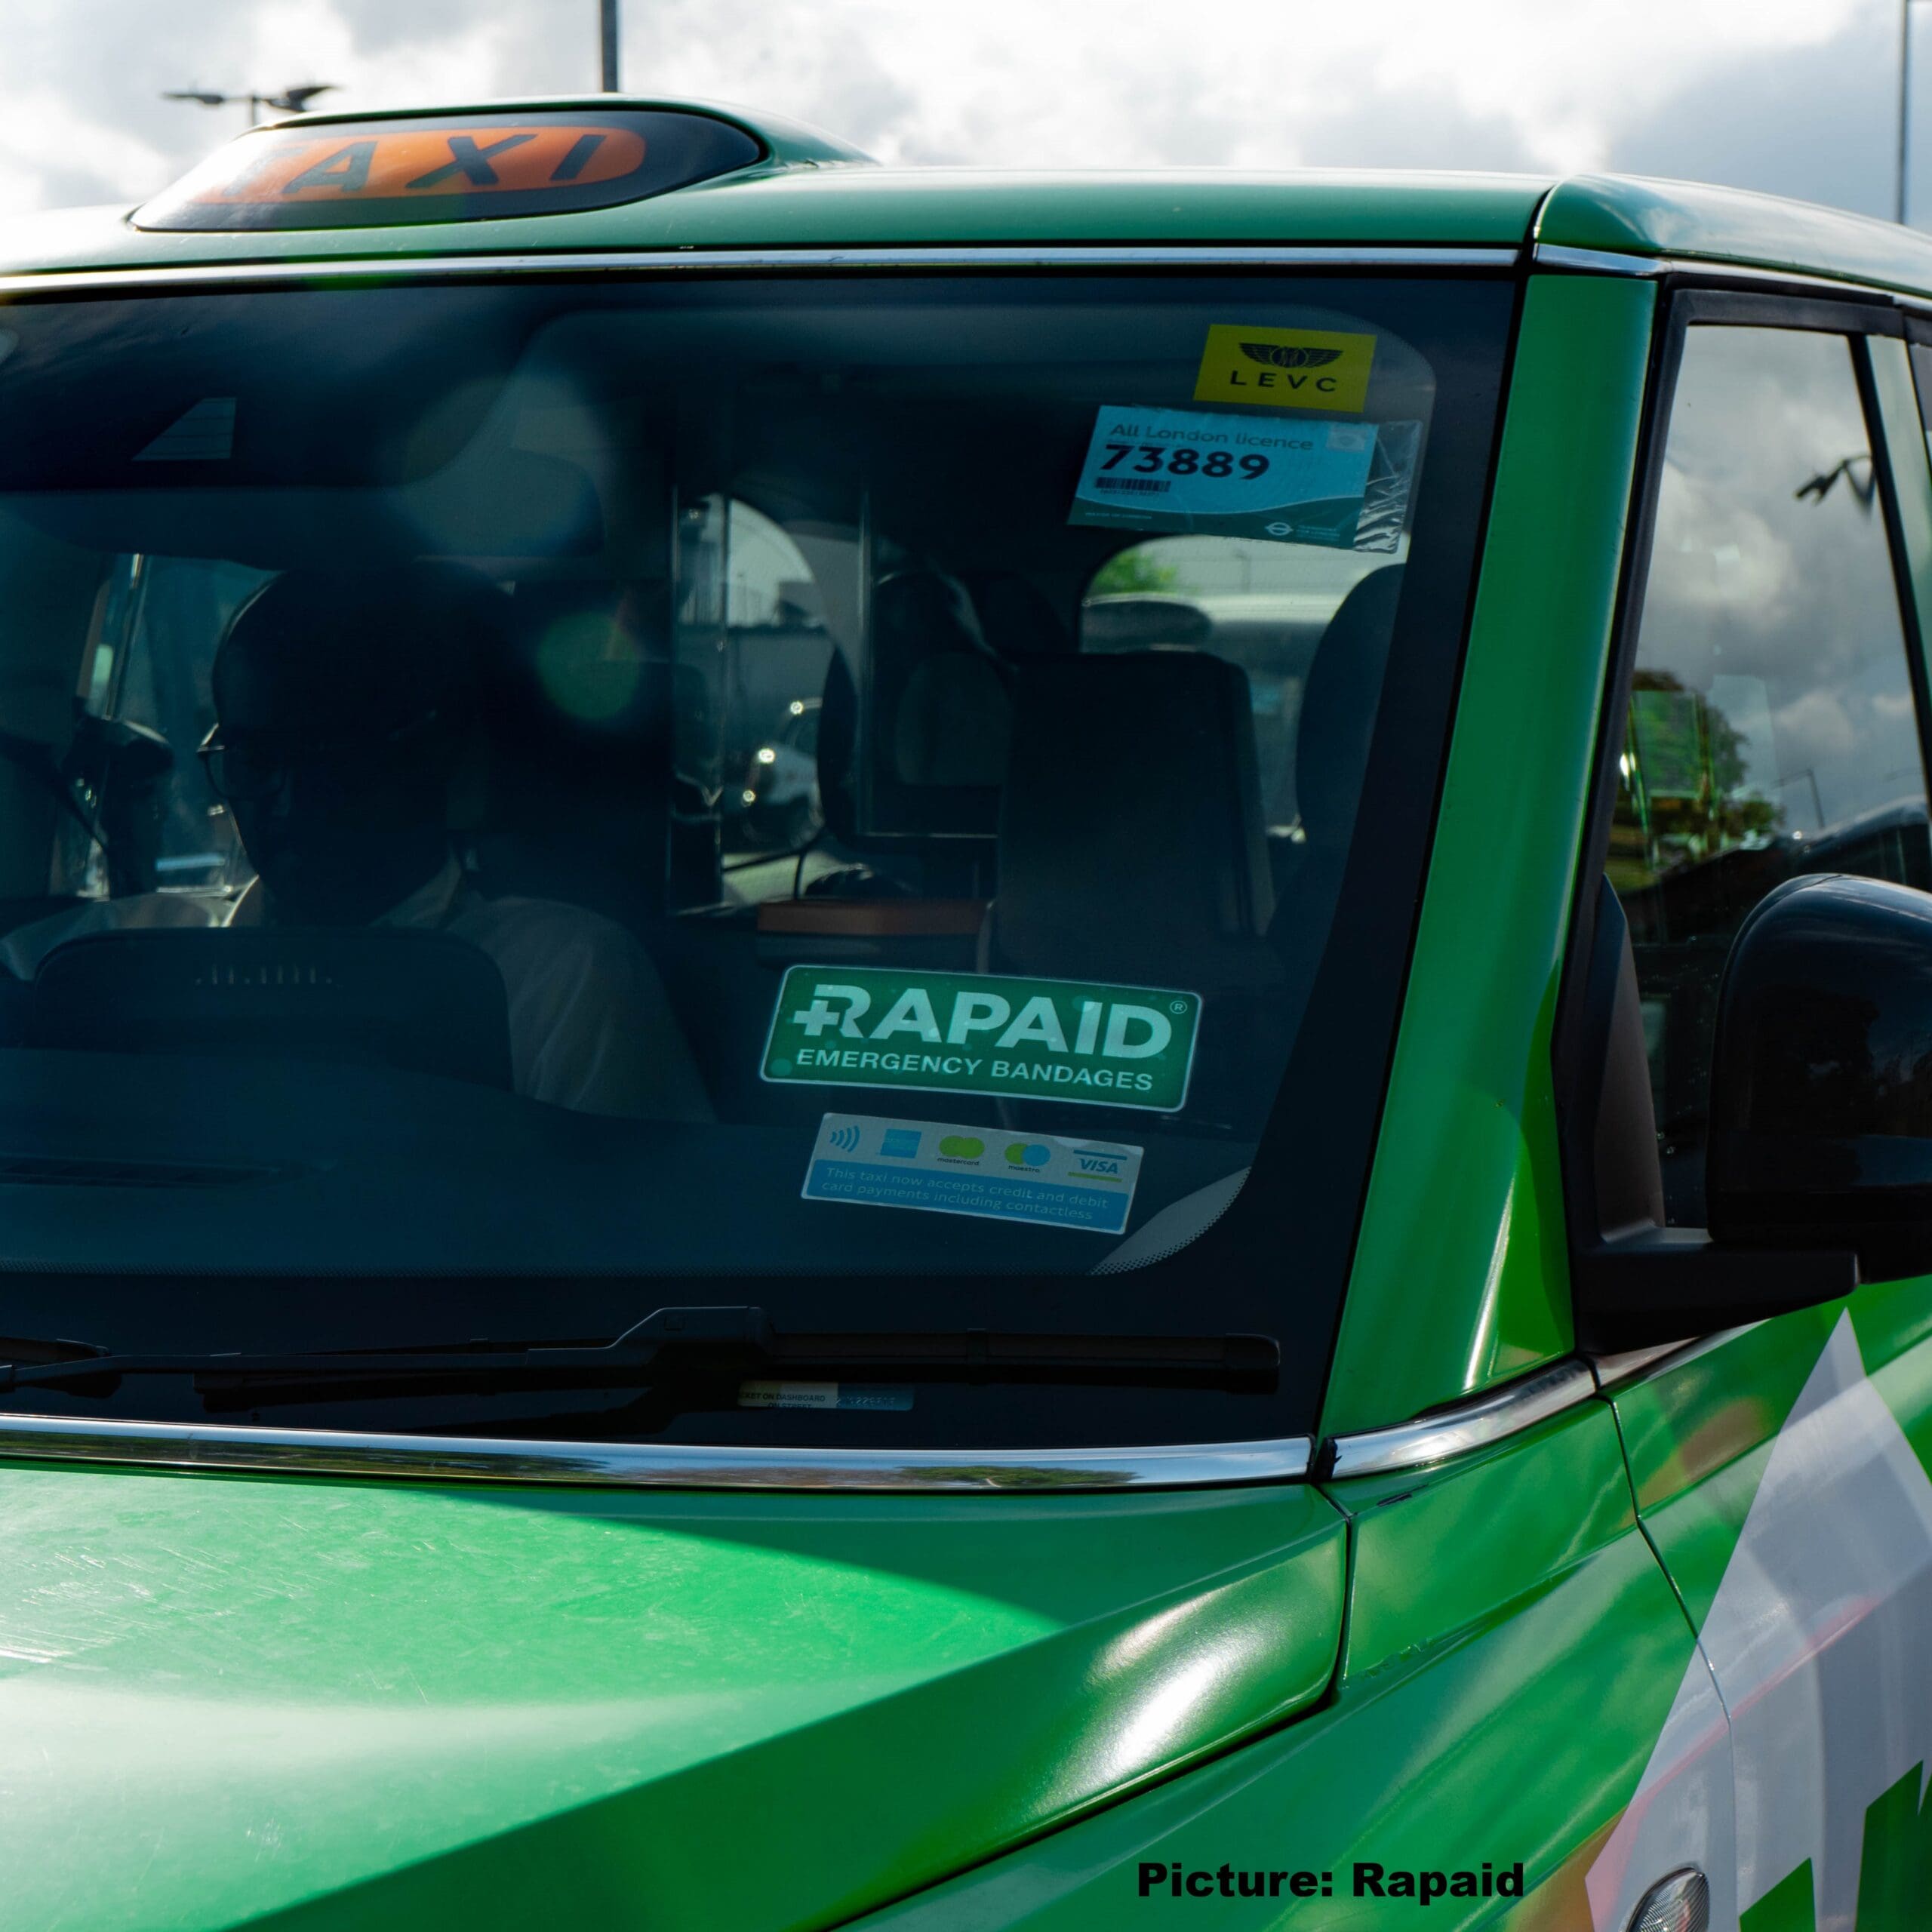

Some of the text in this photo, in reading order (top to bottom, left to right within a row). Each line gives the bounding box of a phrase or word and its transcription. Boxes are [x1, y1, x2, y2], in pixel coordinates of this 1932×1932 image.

[1230, 370, 1337, 392] LEVC
[1110, 423, 1140, 438] All
[1145, 426, 1229, 444] London
[1235, 432, 1314, 451] licence
[1100, 444, 1270, 480] 73889
[793, 983, 1173, 1060] RAPAID
[796, 1048, 1153, 1091] EMERGENCY BANDAGES
[937, 1158, 980, 1166] mastercard
[1008, 1164, 1041, 1173] maestro
[1079, 1158, 1118, 1174] VISA
[822, 1180, 1094, 1220] card payments including contactless
[826, 1168, 1109, 1208] This taxi now accepts credit and debit
